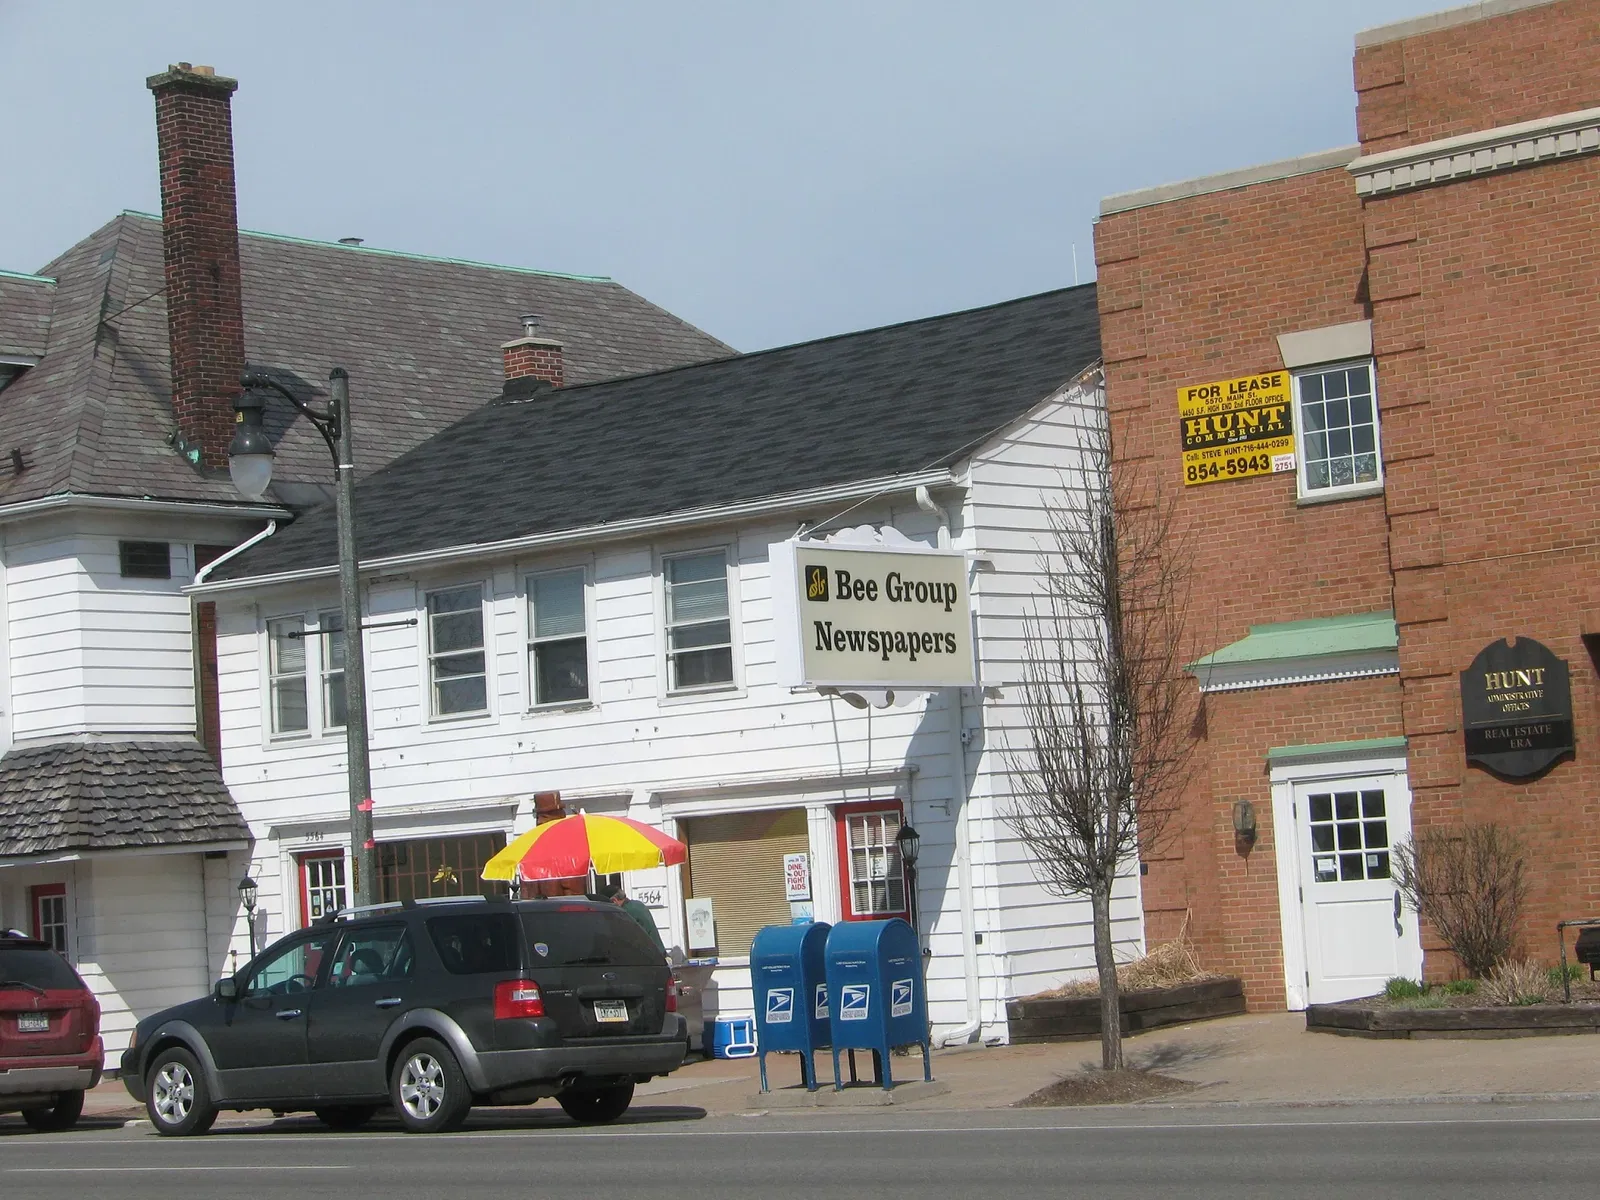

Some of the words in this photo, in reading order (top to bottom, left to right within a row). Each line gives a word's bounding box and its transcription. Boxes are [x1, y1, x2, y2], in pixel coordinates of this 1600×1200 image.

[1188, 385, 1221, 401] FOR
[1229, 375, 1282, 395] LEASE
[1226, 393, 1244, 402] MAIN
[1207, 404, 1220, 413] HIGH
[1221, 402, 1233, 411] END
[1245, 397, 1263, 407] FLOOR
[1265, 394, 1285, 404] OFFICE
[1185, 405, 1285, 437] HUNT
[1186, 422, 1285, 445] COMMERCIAL
[1202, 449, 1222, 459] STEVE
[1187, 453, 1270, 481] 854-5943
[1275, 462, 1293, 471] 2751
[834, 570, 878, 601] Bee
[885, 572, 957, 612] Group
[814, 621, 957, 661] Newspapers
[1485, 668, 1545, 690] HUNT
[1485, 728, 1511, 739] REAL
[1514, 724, 1552, 736] ESTATE
[1510, 738, 1532, 748] ERA
[787, 863, 803, 871] DINE
